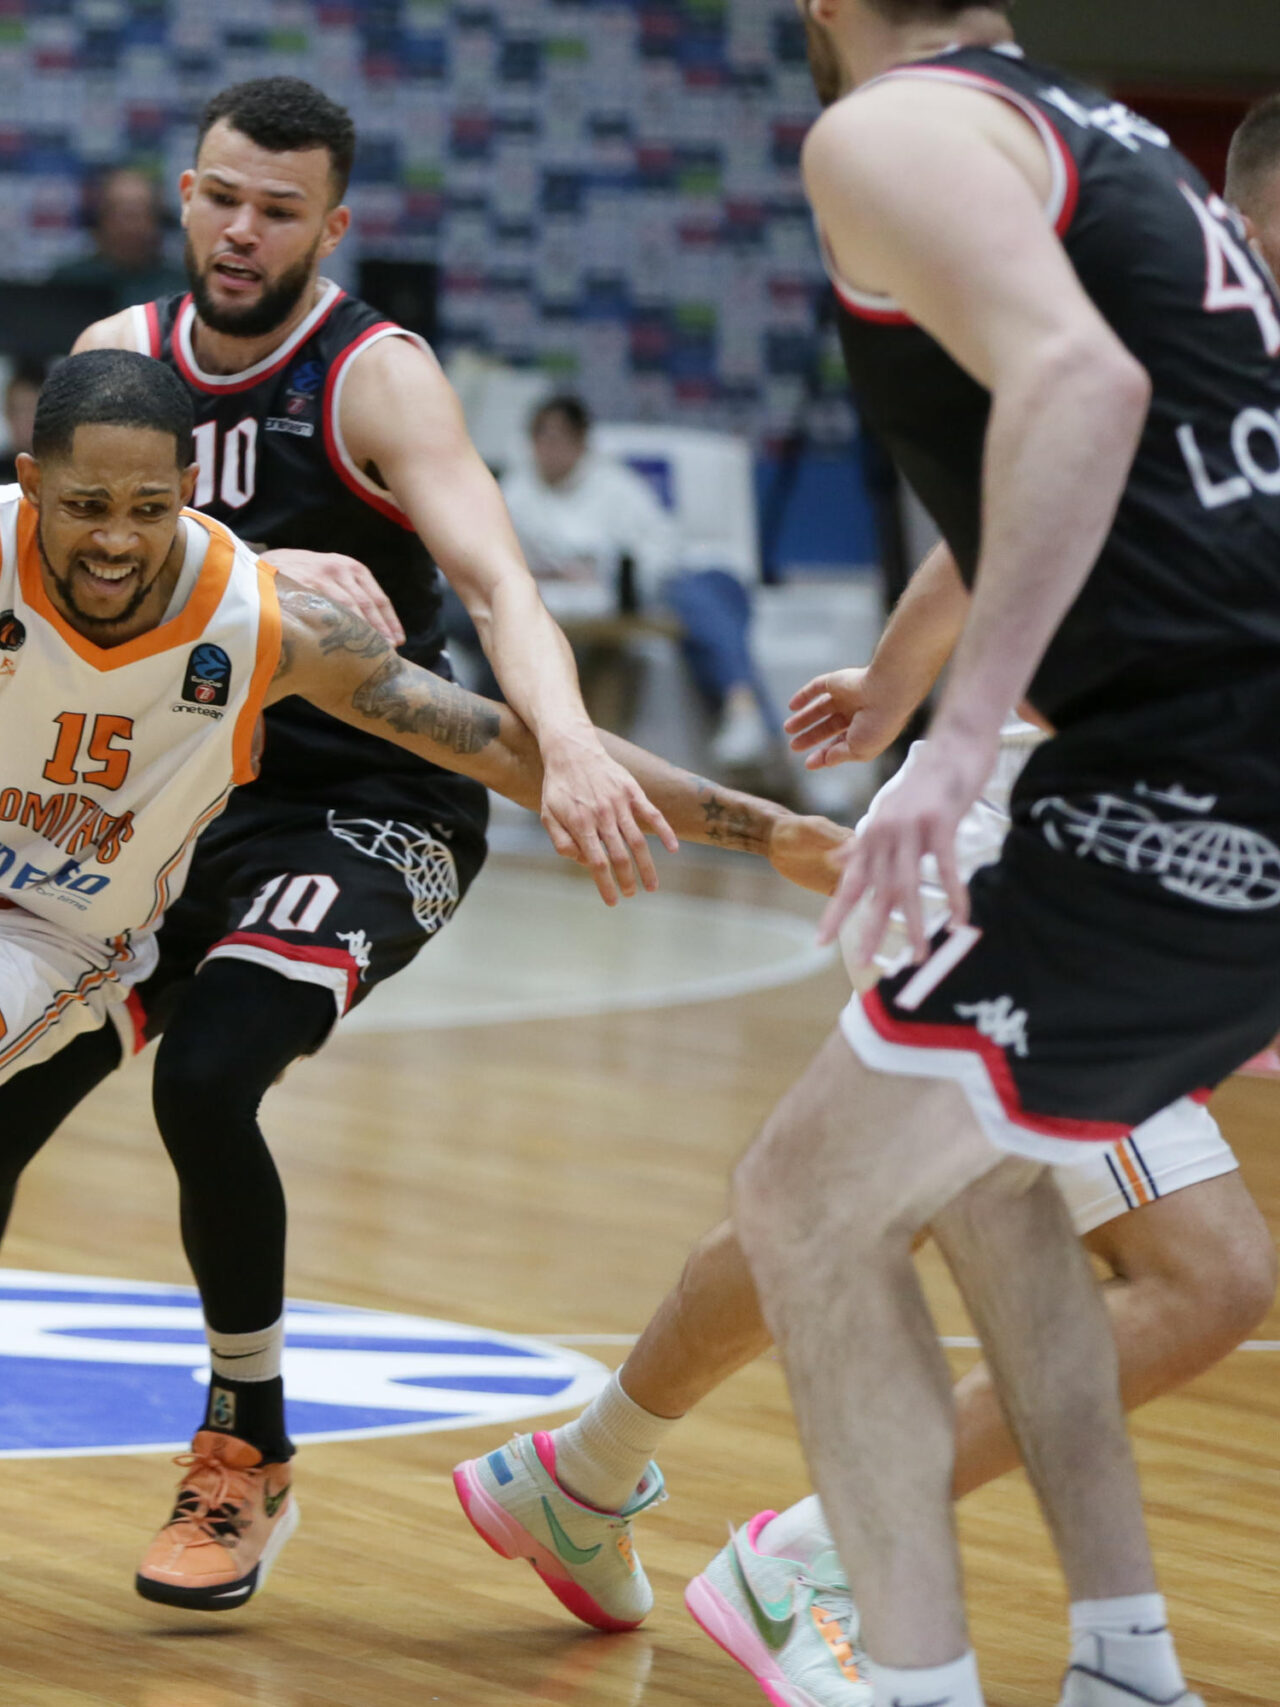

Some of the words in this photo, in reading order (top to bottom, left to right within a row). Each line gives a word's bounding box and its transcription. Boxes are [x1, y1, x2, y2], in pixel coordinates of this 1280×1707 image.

[192, 416, 258, 509] 10
[42, 711, 134, 791] 15
[238, 872, 340, 933] 10
